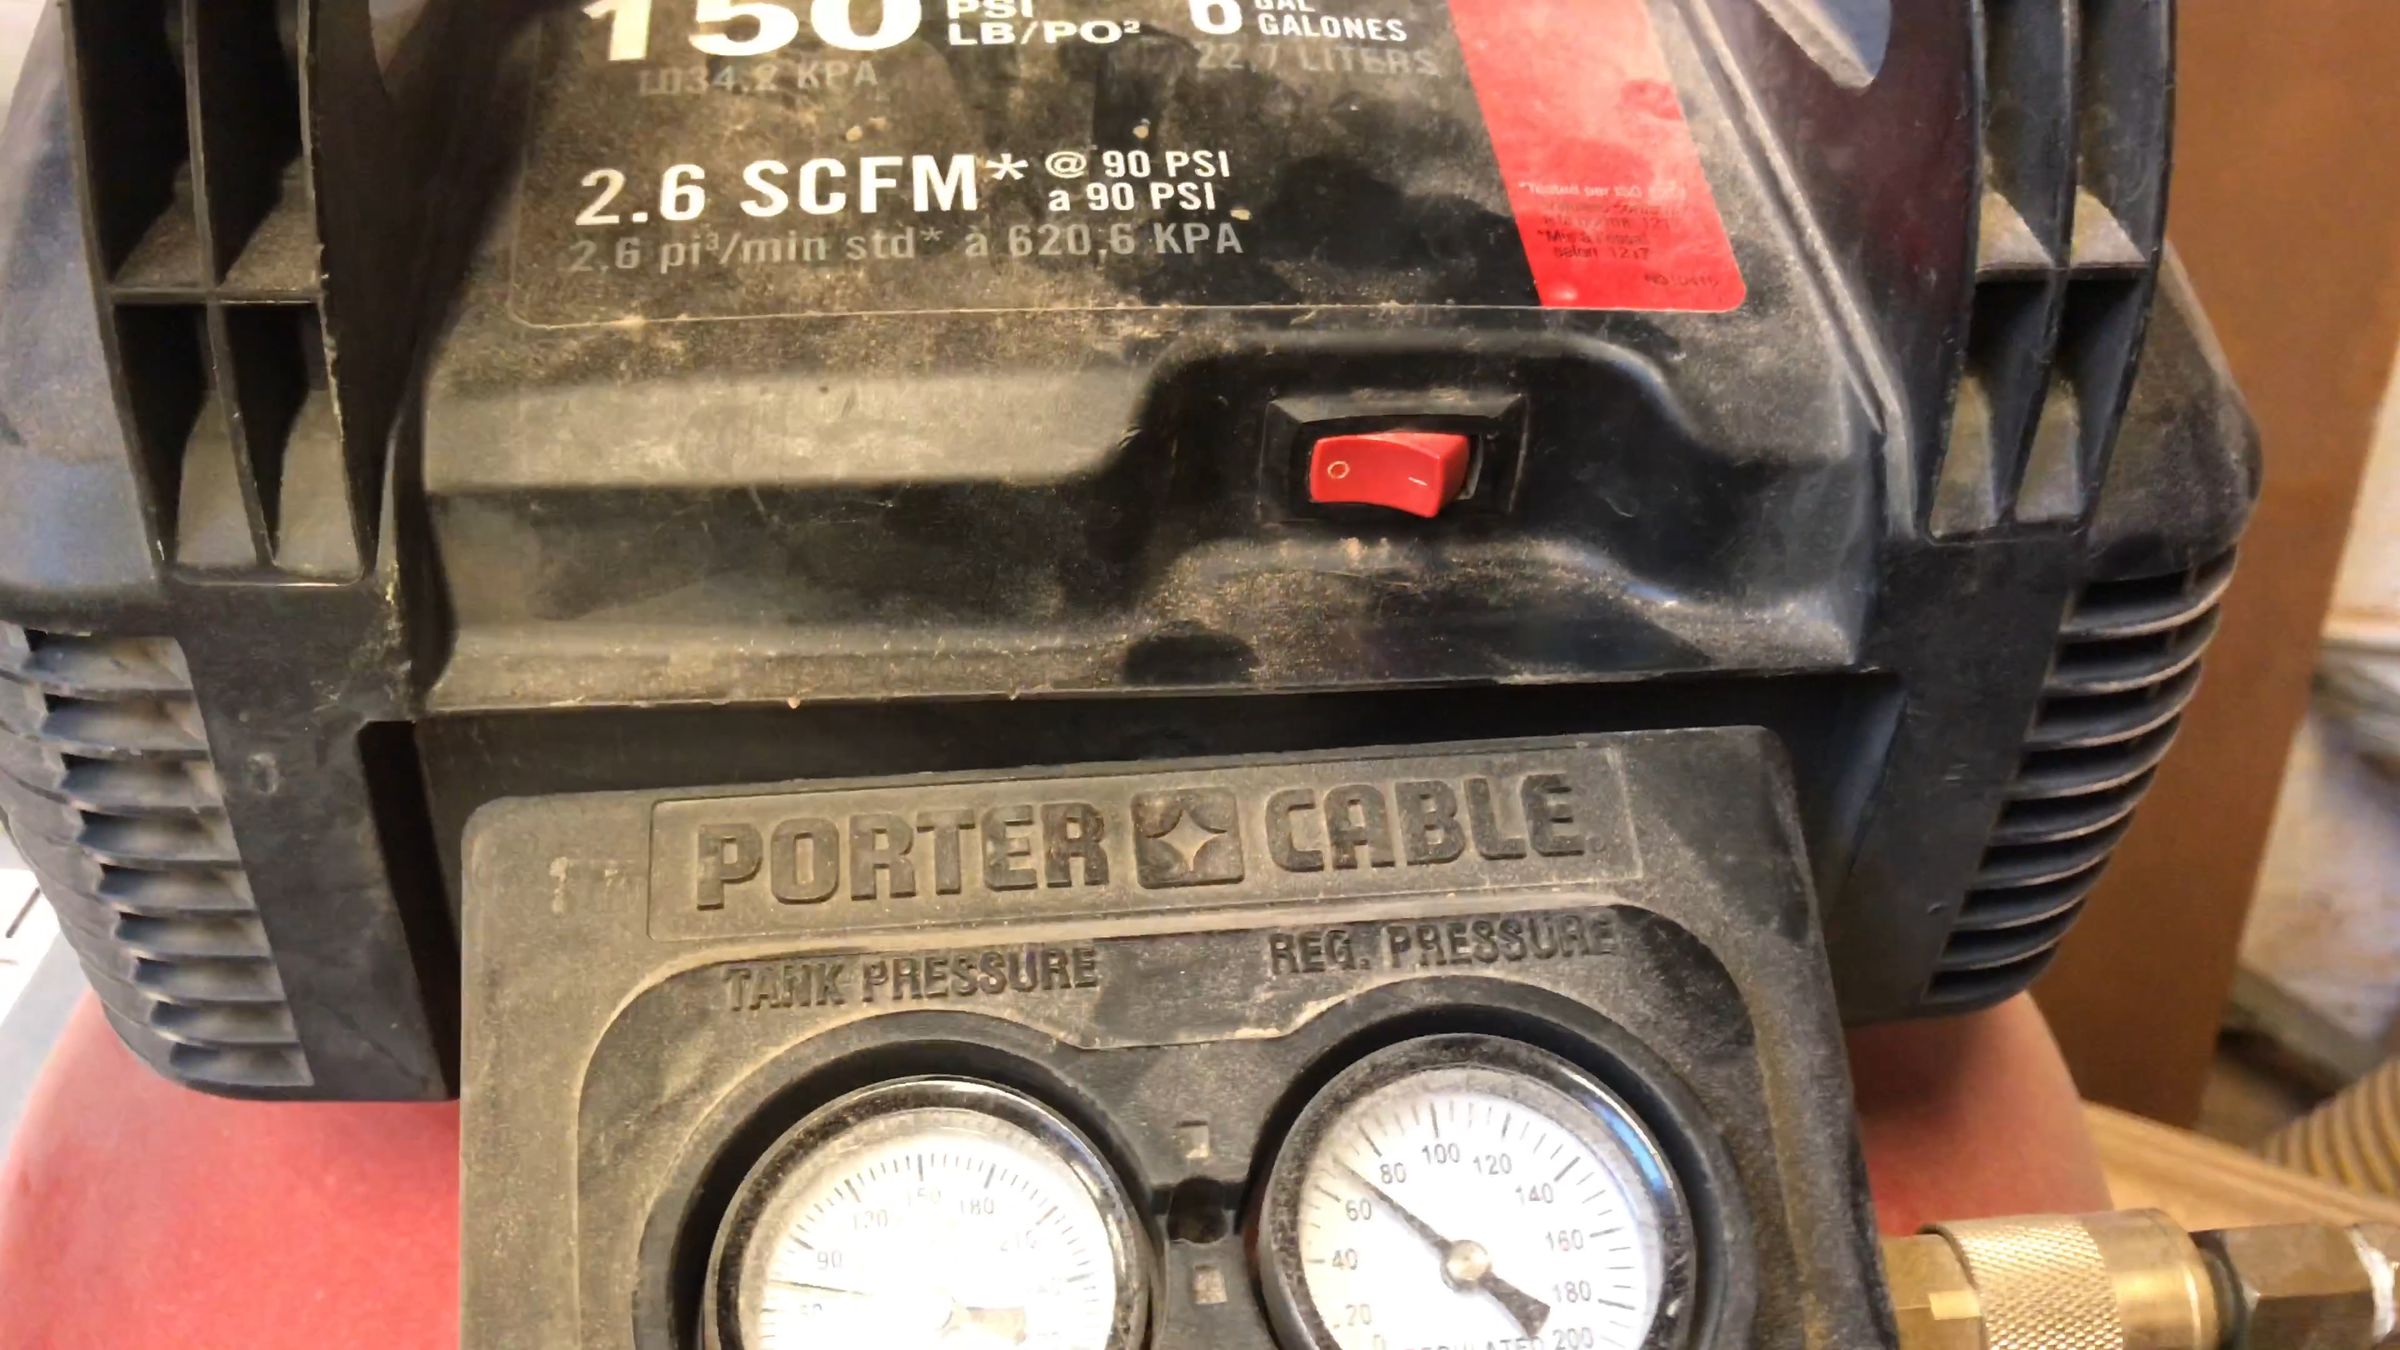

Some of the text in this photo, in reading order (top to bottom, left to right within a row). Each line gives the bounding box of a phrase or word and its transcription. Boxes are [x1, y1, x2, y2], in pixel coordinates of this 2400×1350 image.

[947, 0, 1034, 19] PSI
[583, 0, 922, 61] 150
[1258, 13, 1408, 42] GALONES
[1300, 43, 1442, 78] LITERS
[796, 59, 879, 90] KPA
[1045, 150, 1231, 179] @ 90 PSI
[575, 163, 707, 226] 2.6
[1048, 181, 1216, 212] a 90 PSI
[567, 236, 641, 273] 2.6
[964, 226, 988, 257] à
[1007, 222, 1136, 257] 620.6
[1153, 222, 1244, 255] KPA
[696, 772, 1585, 911] PORTER CABLE
[1269, 911, 1617, 975] REG. PRESSURE
[724, 947, 1100, 1012] TANK PRESSURE
[1421, 1142, 1461, 1165] 100
[1473, 1153, 1512, 1175] 120
[1379, 1162, 1407, 1184] 80
[1515, 1182, 1554, 1205] 140
[959, 1196, 995, 1216] 180
[1345, 1198, 1372, 1222] 60
[1545, 1228, 1584, 1251] 160
[816, 1250, 843, 1271] 90
[1331, 1248, 1358, 1271] 40
[1552, 1280, 1592, 1303] 180
[1345, 1303, 1373, 1326] 20
[1552, 1326, 1594, 1350] 200
